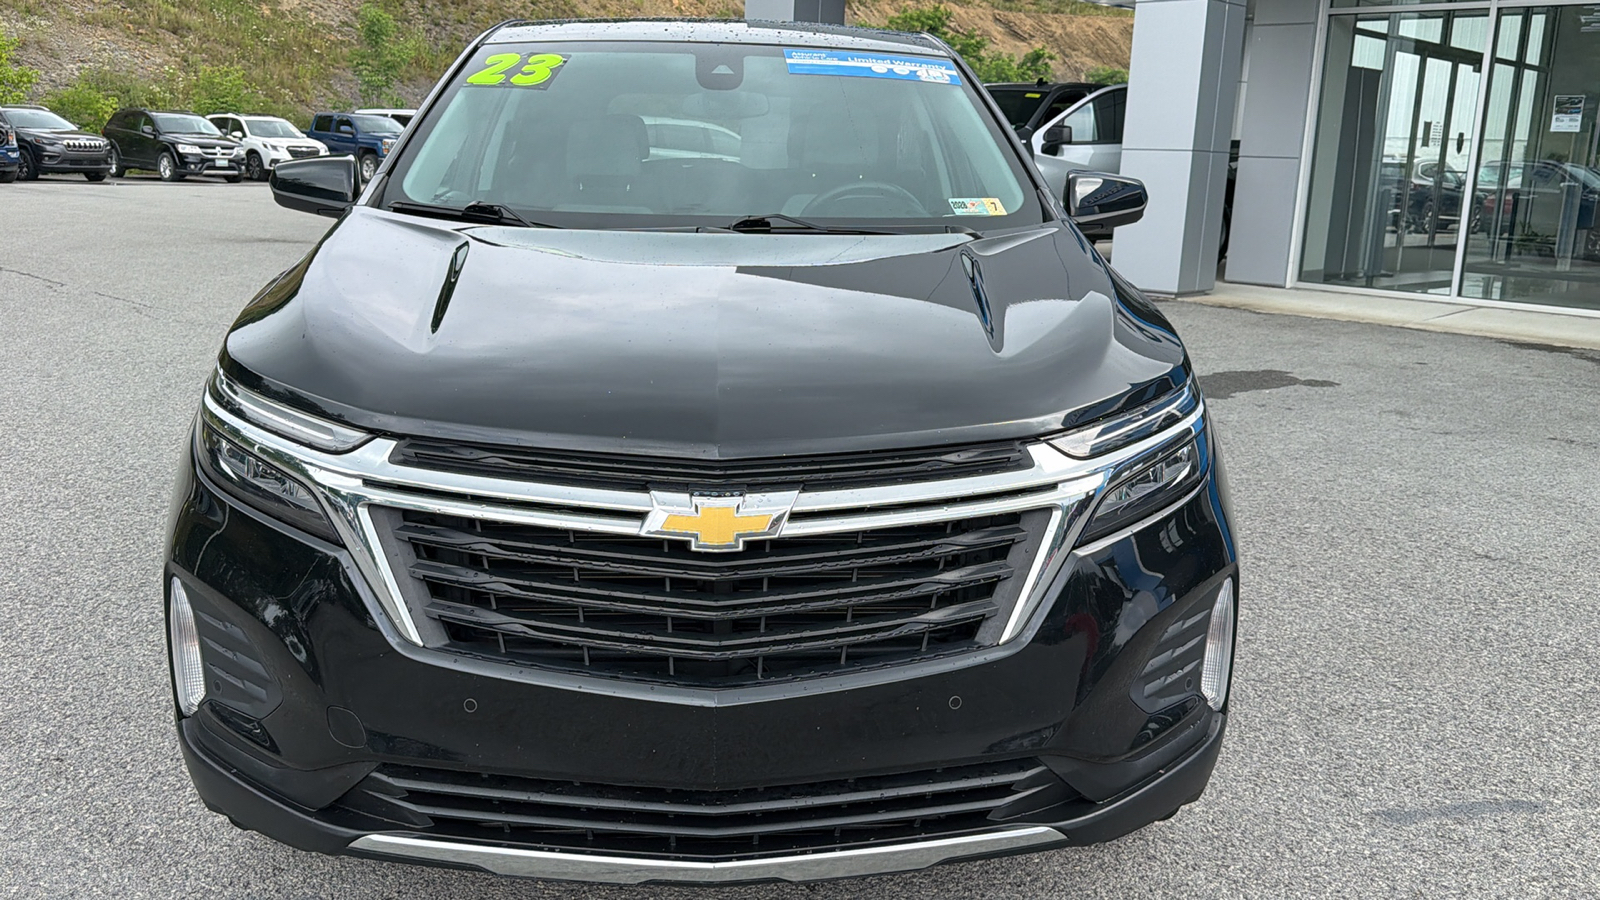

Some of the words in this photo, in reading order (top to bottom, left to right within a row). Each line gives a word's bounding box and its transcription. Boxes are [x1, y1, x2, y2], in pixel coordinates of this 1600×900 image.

[466, 52, 563, 86] 23
[847, 56, 890, 64] Limited
[892, 60, 946, 70] Warranty
[990, 202, 998, 211] 7
